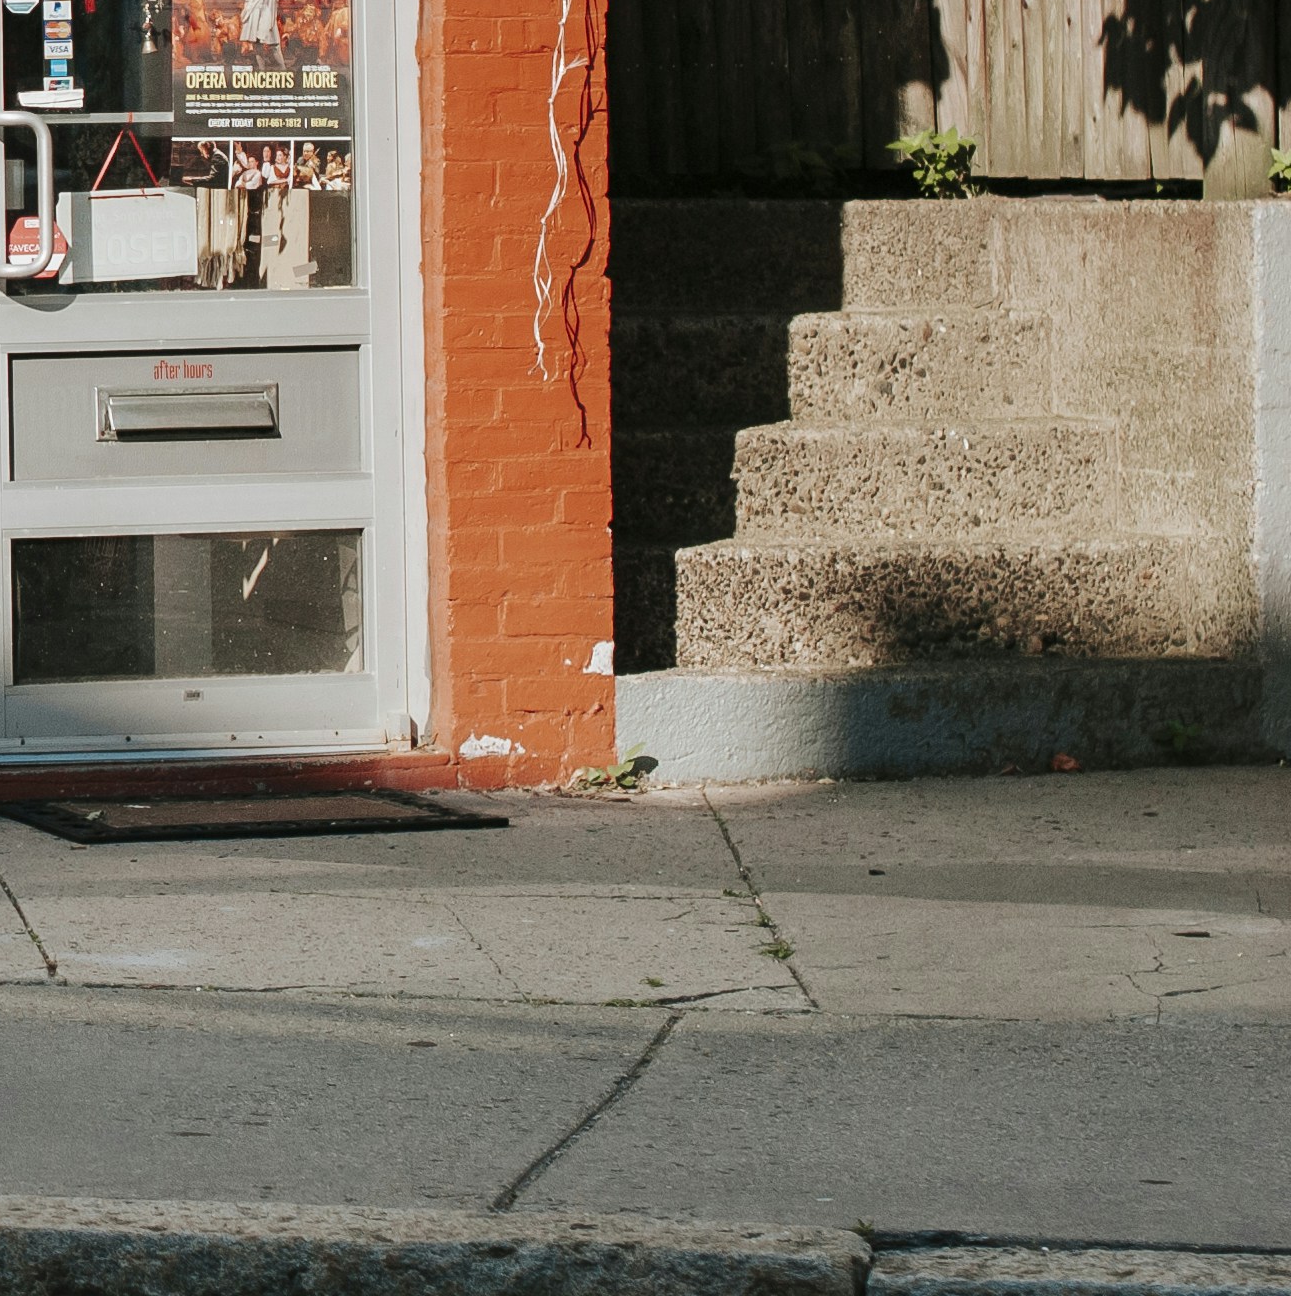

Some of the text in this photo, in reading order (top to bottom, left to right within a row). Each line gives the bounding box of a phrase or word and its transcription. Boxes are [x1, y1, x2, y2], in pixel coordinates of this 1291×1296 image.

[49, 45, 69, 53] VISA
[186, 71, 338, 89] OPERA CONCERTS MORE
[78, 231, 192, 266] LOSED
[153, 359, 213, 380] after hours
